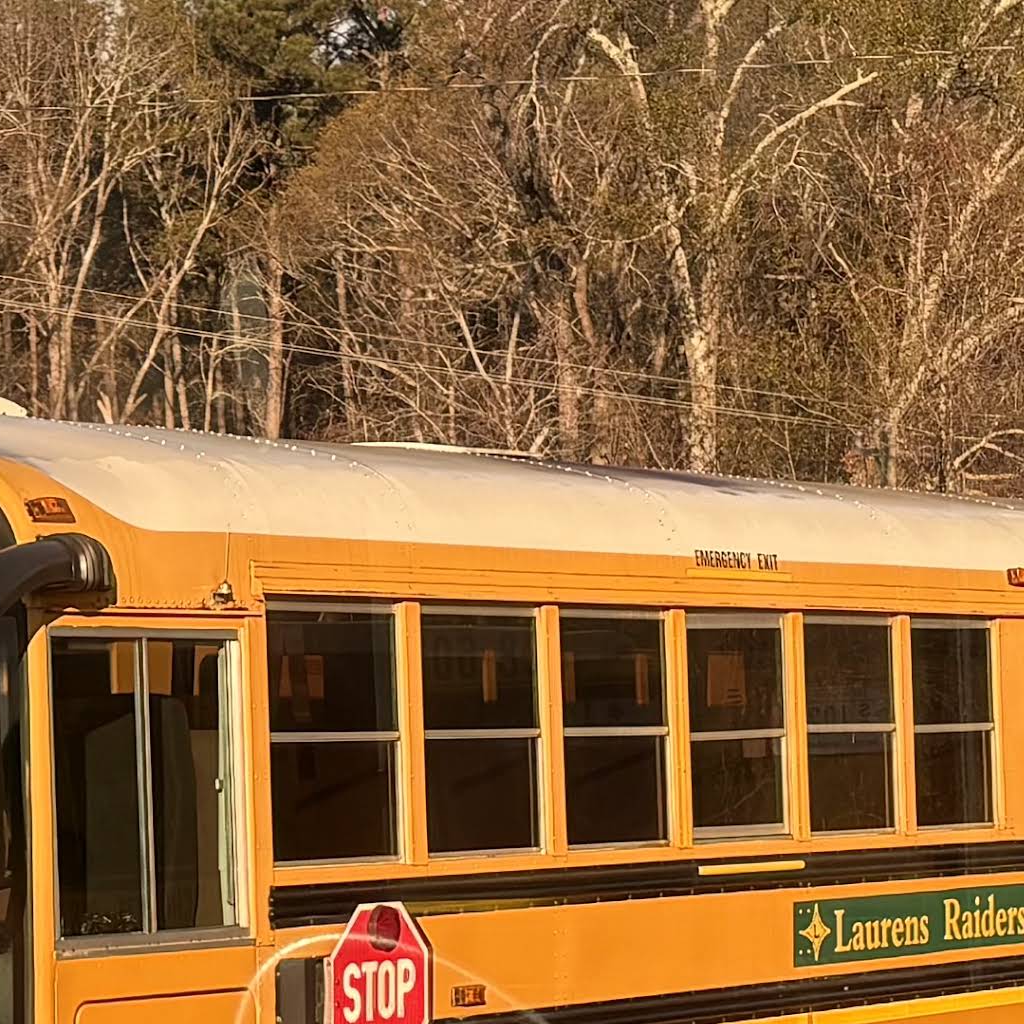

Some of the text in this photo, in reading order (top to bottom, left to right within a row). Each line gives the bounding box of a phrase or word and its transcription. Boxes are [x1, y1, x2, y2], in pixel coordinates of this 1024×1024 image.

[694, 549, 779, 572] EMERGENCY EXIT
[833, 893, 1024, 953] Laurens Raiders
[342, 957, 417, 1024] STOP
